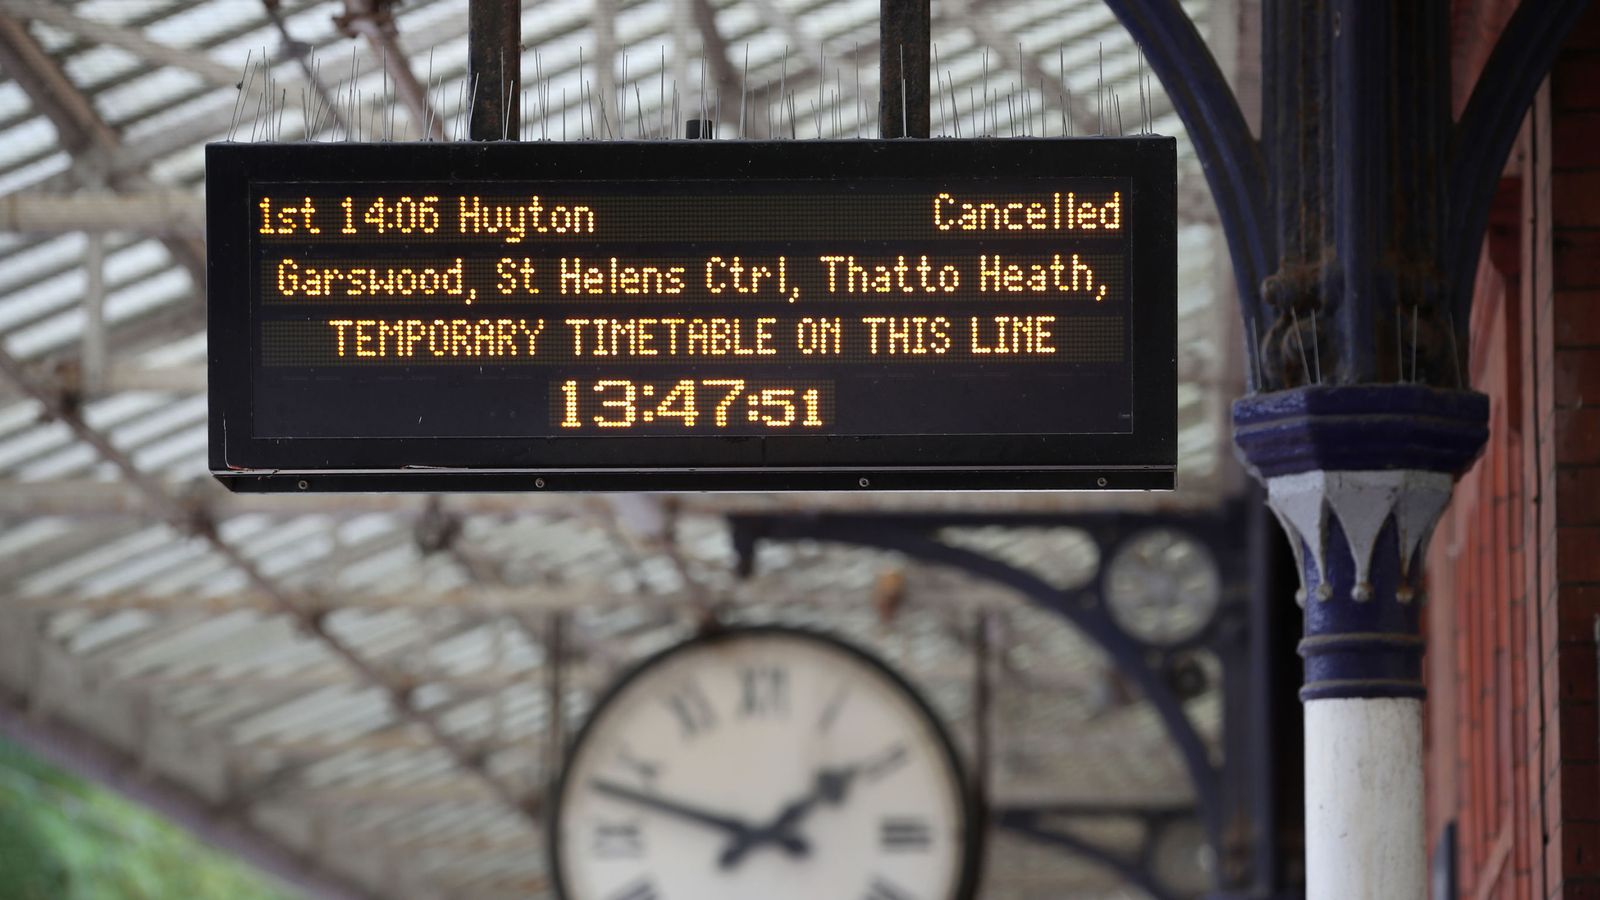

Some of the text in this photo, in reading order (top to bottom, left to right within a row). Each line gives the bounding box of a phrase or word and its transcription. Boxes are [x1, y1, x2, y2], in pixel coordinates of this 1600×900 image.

[259, 191, 1120, 244] 1st 14:06 Huyton Cancelled
[278, 254, 1107, 305] Garswood, St Helens Ctrl, Thatto Heath,
[328, 315, 1056, 357] TEMPORARY TIMETABLE ON THIS LINE
[560, 379, 823, 428] 13:47:51
